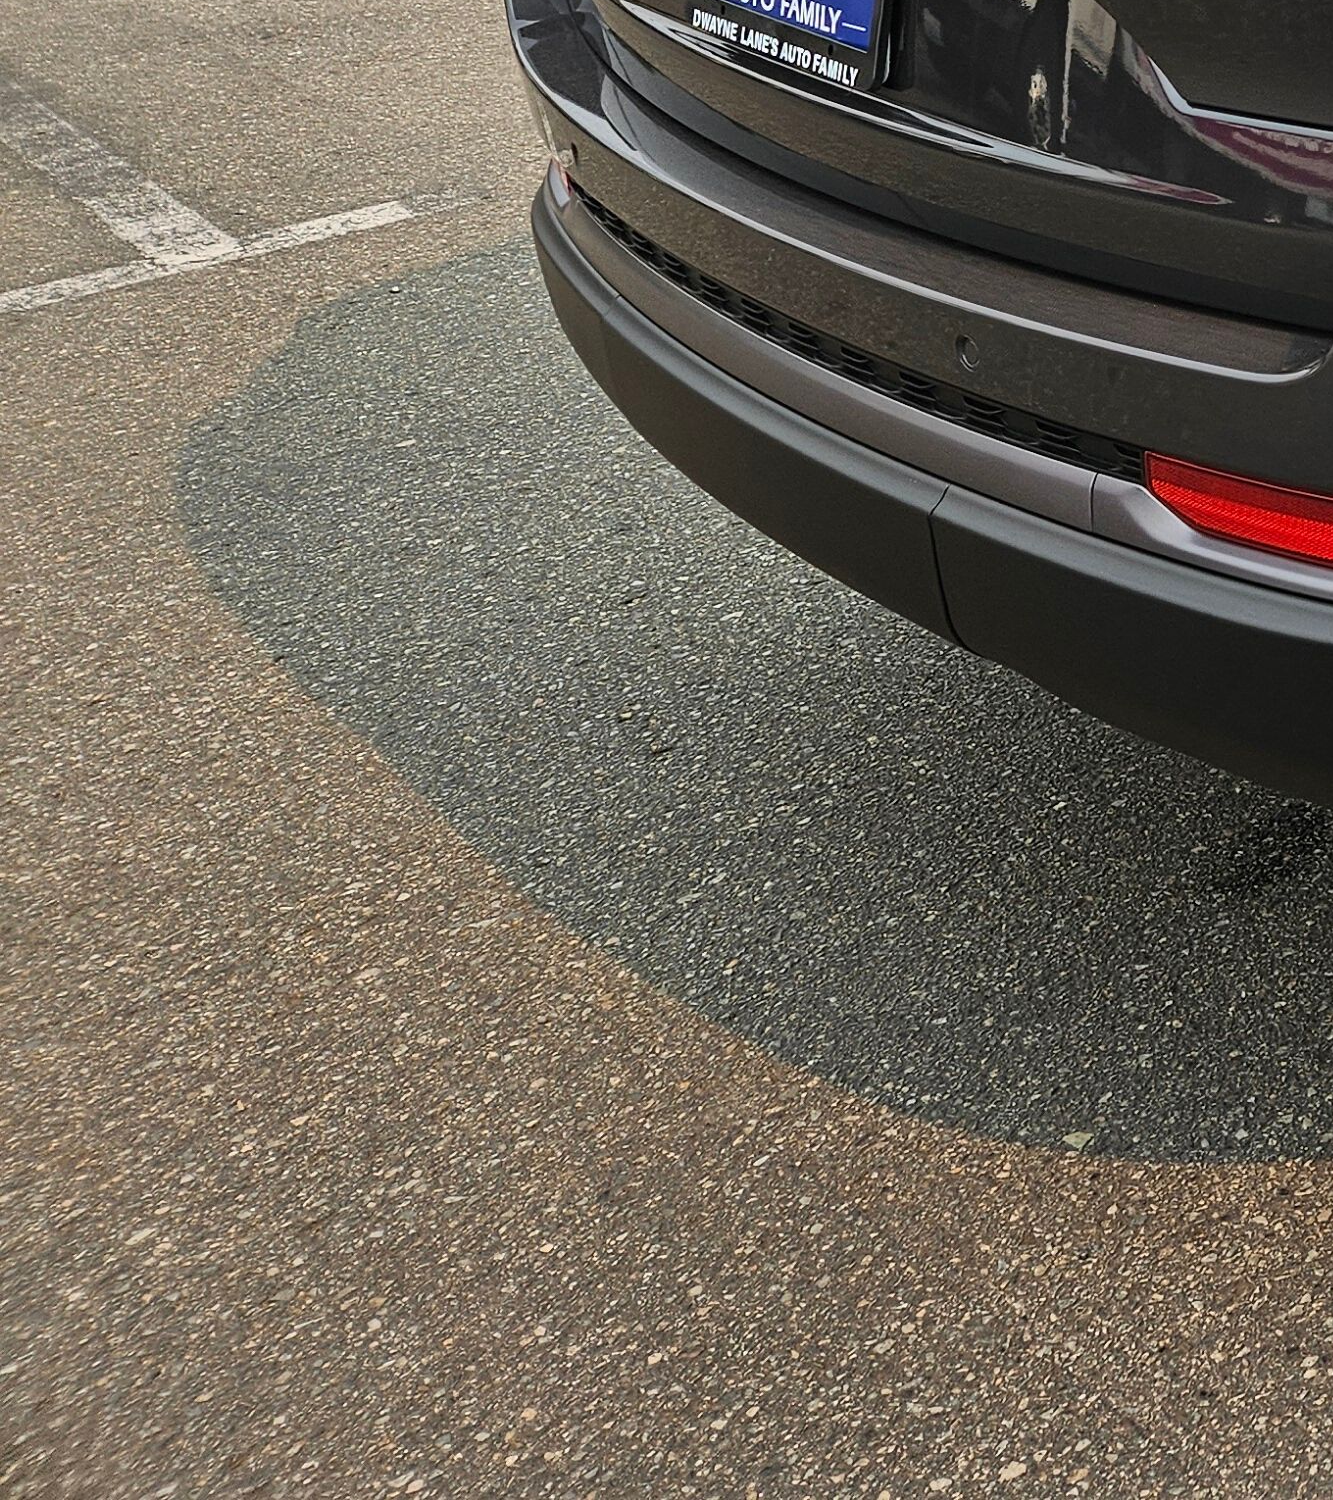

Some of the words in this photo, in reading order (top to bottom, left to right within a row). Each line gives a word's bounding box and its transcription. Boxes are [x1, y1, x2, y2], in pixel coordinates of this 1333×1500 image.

[692, 9, 738, 41] DWAYNE
[740, 26, 778, 57] LANE'S
[779, 41, 811, 69] AUTO
[812, 53, 859, 87] FAMILY
